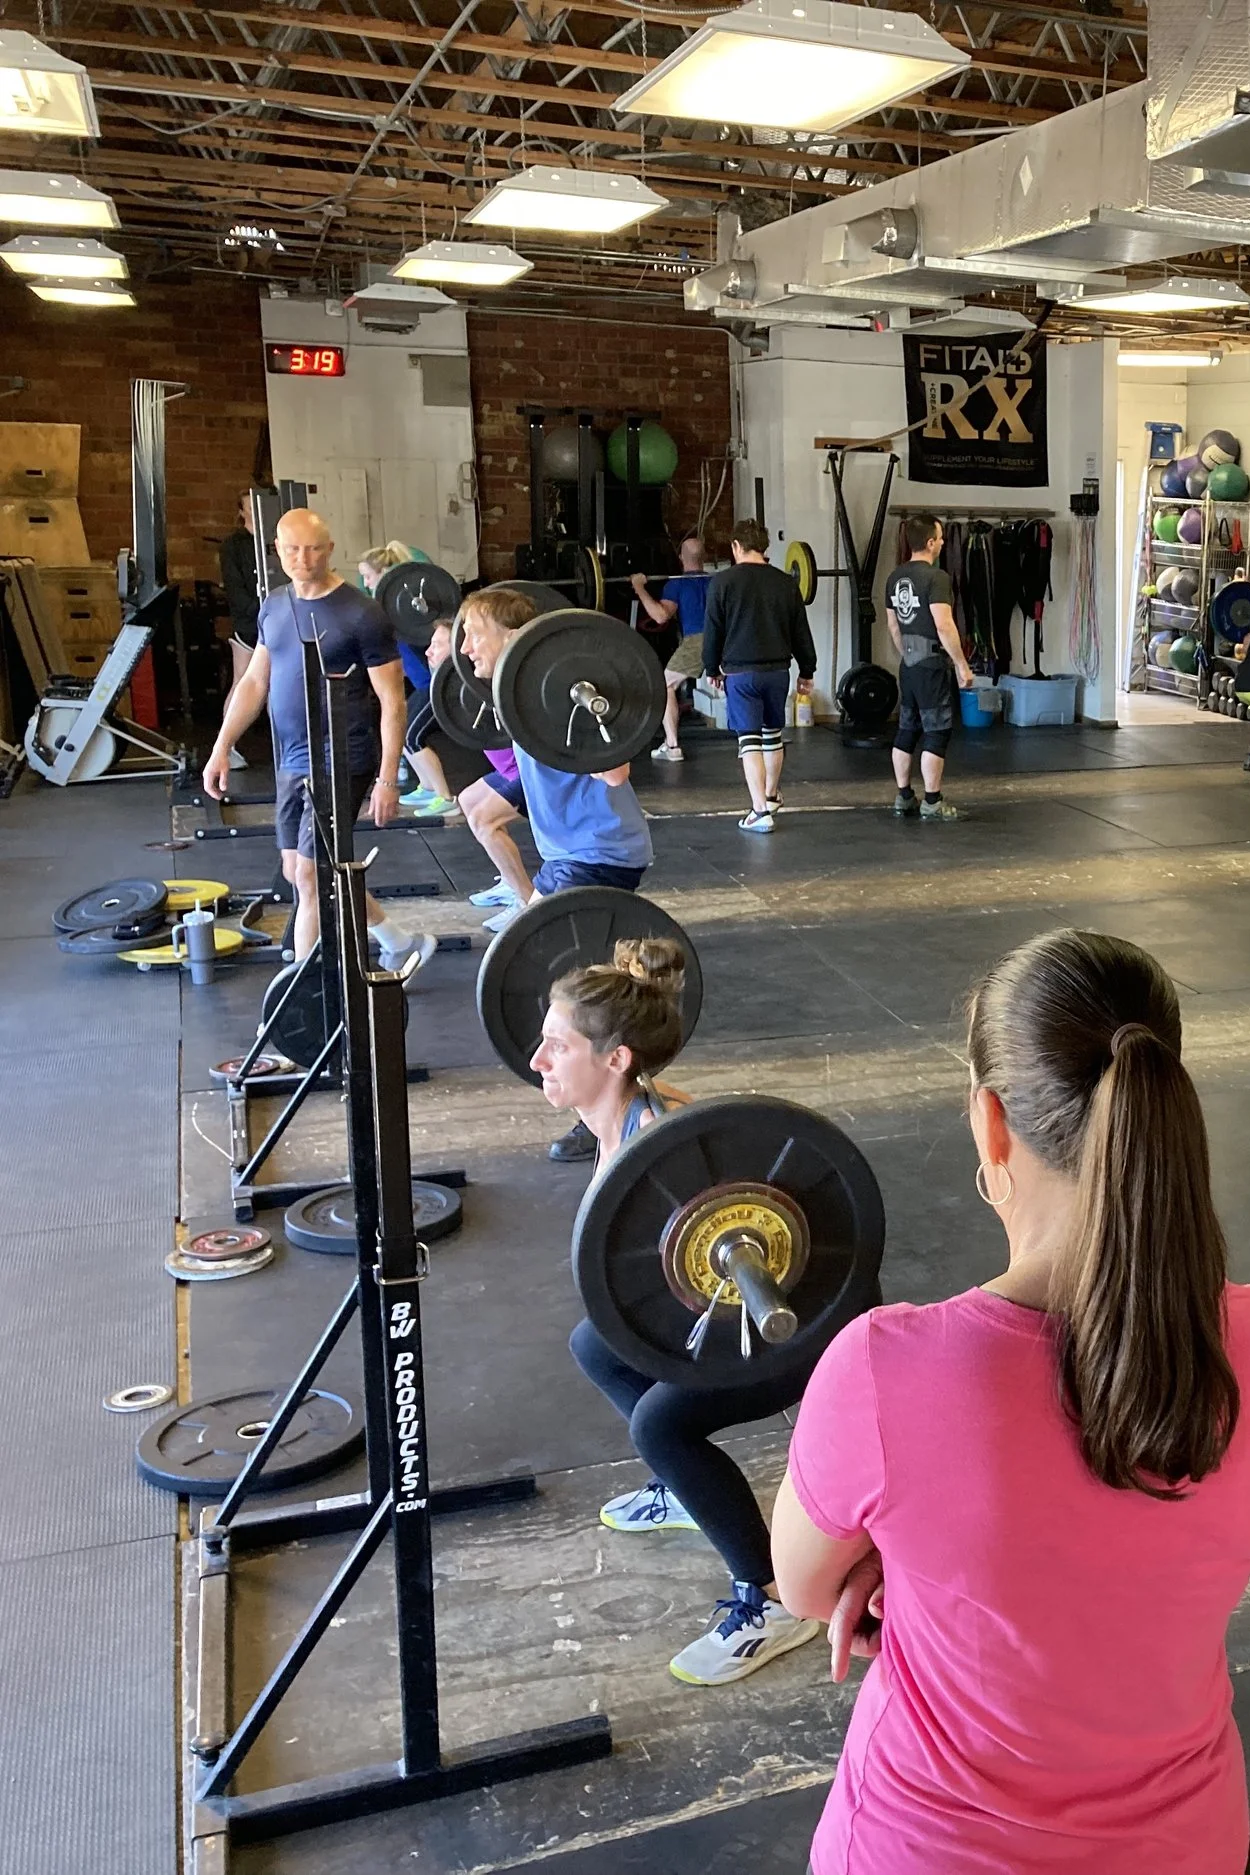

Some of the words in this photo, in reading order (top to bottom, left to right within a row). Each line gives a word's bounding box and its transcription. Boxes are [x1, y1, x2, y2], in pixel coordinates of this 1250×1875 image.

[919, 343, 1032, 375] FITAID
[920, 371, 1034, 443] RX
[973, 455, 995, 463] YOUR
[996, 457, 1035, 466] LIFESTYLE
[389, 1302, 416, 1339] BW
